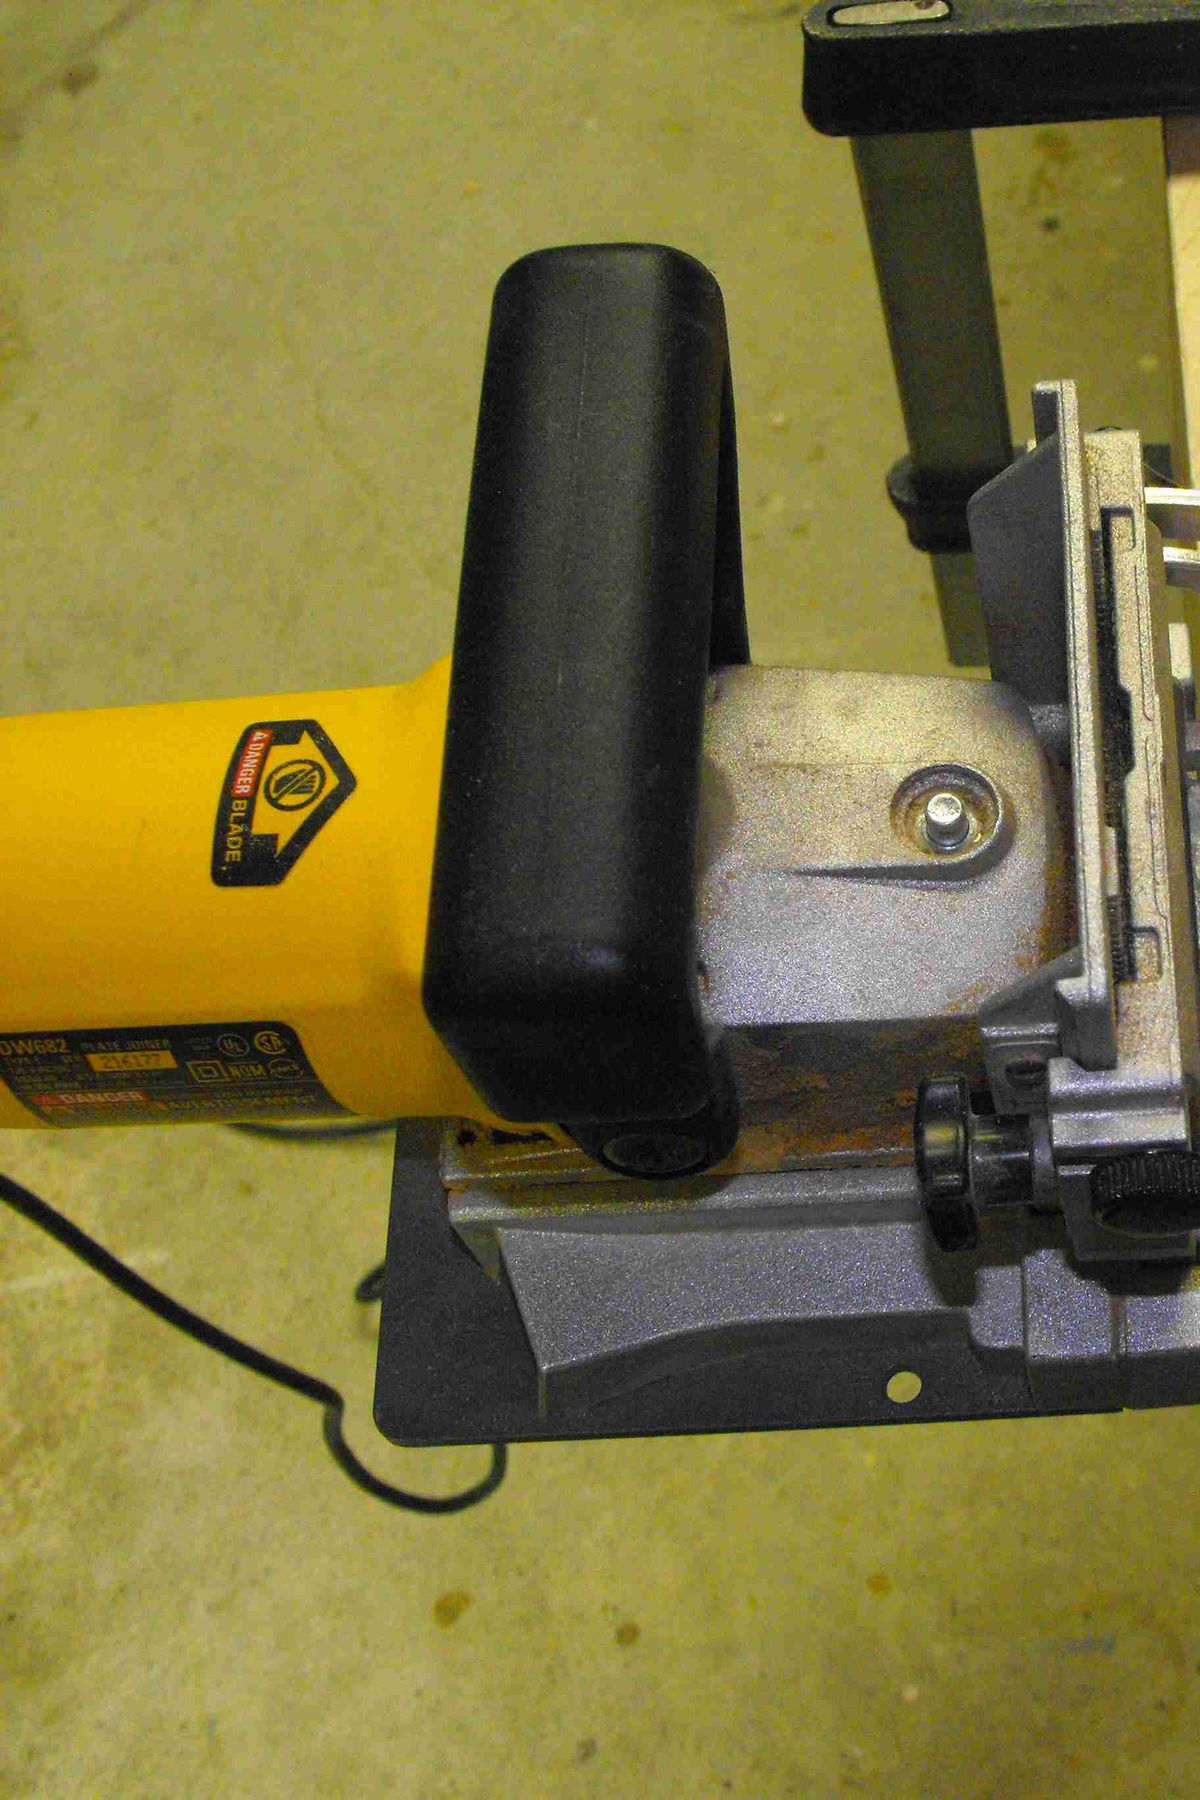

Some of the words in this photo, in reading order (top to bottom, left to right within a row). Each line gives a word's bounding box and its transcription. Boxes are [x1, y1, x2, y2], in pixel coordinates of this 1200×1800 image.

[234, 742, 265, 794] DANGER
[225, 799, 248, 863] BLADE
[60, 1091, 143, 1103] DANGER
